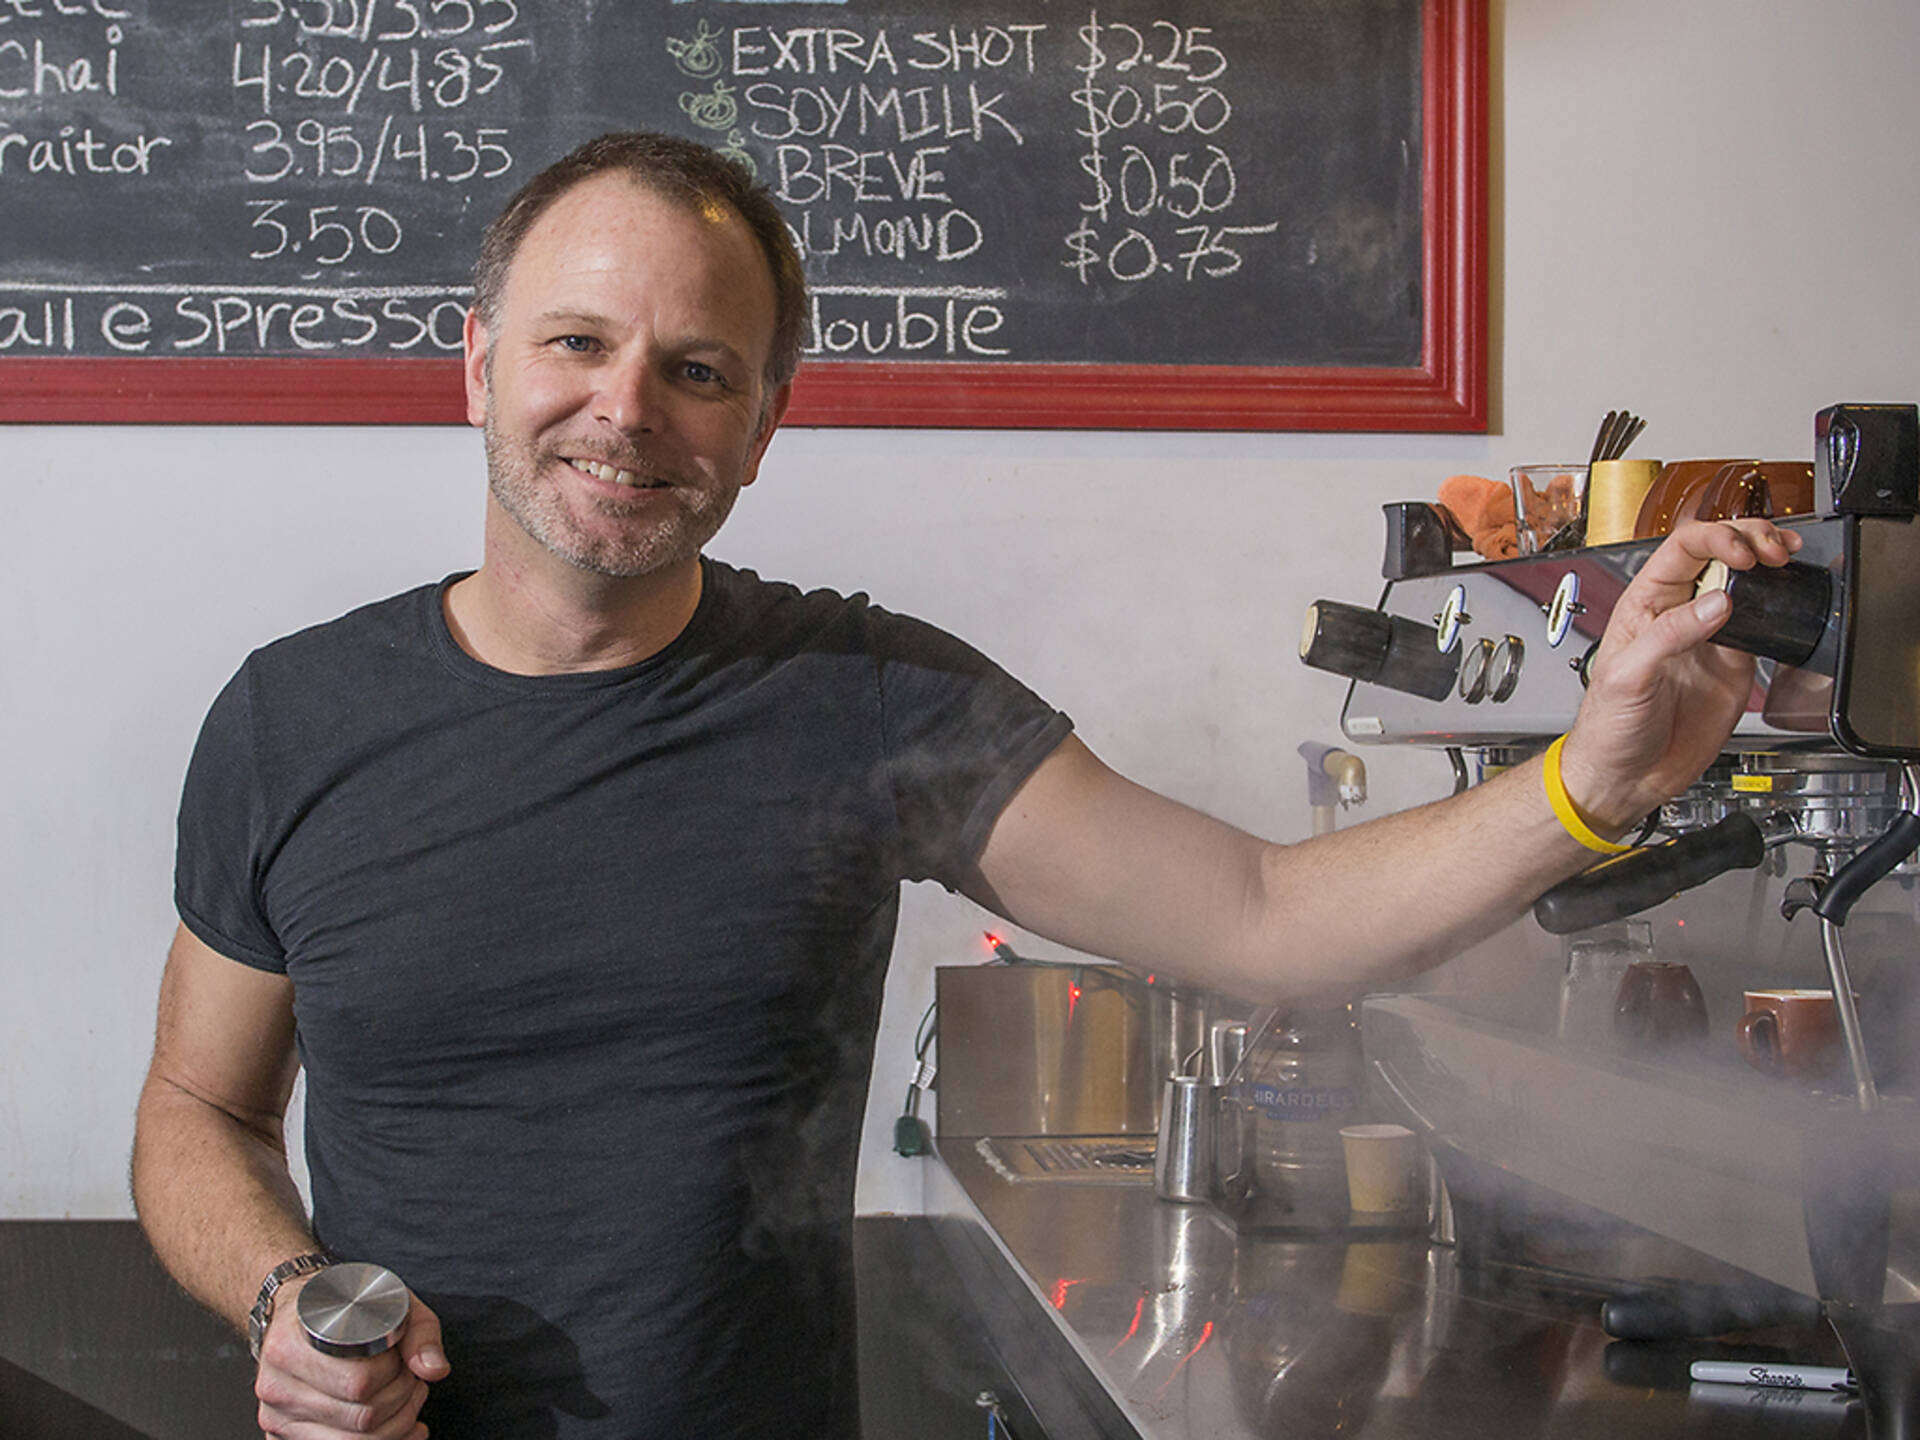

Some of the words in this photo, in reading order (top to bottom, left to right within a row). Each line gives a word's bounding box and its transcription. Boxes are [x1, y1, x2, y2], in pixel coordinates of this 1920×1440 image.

[0, 24, 123, 96] Chai
[232, 39, 533, 113] 4.20/4.85
[732, 25, 898, 75] EXTRA
[907, 23, 1047, 73] SHOT
[1075, 9, 1228, 82] $2.25
[1070, 78, 1232, 148] $0.50
[0, 121, 172, 175] raitor
[244, 115, 513, 185] 3.95/4.35
[774, 144, 952, 204] BREVE
[1079, 144, 1237, 222] $0.50
[246, 200, 402, 264] 3.50
[1060, 217, 1279, 285] $0.75
[1749, 1366, 1806, 1387] Sharpie
